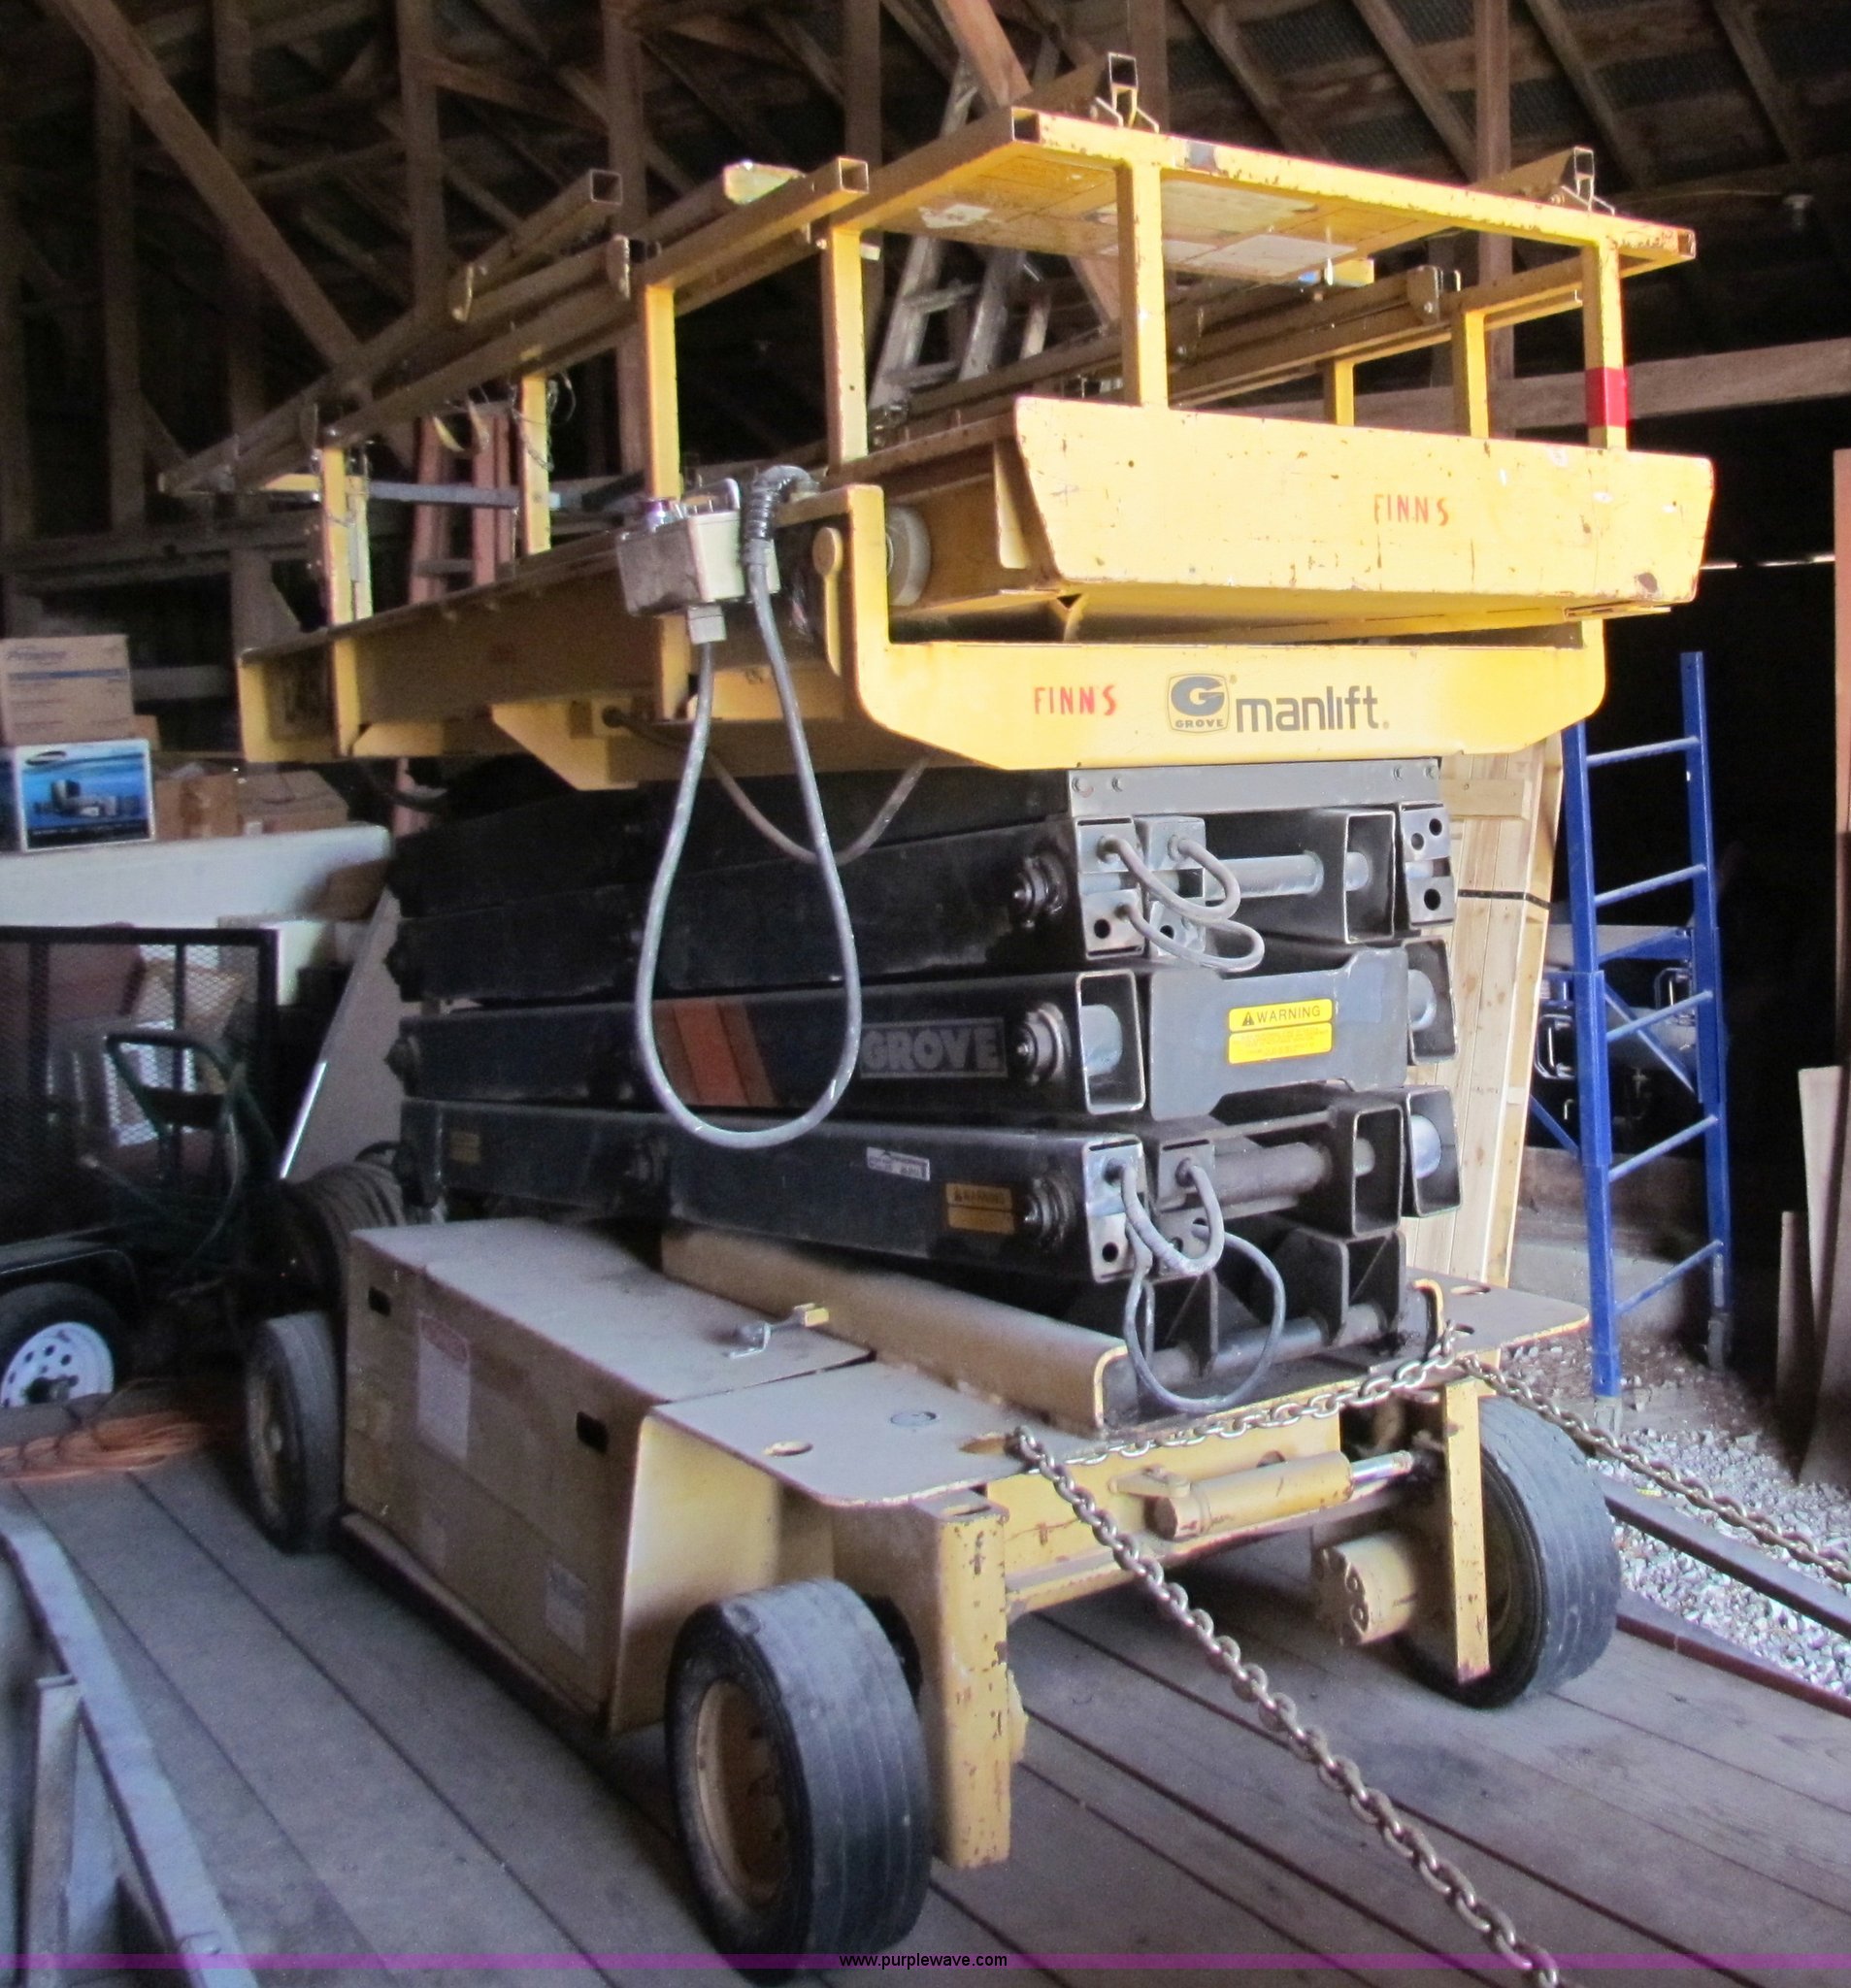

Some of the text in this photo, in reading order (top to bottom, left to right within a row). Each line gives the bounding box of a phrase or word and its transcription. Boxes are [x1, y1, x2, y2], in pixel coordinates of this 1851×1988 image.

[1174, 718, 1224, 729] GROVE
[1236, 684, 1379, 733] manlift
[1257, 1005, 1321, 1024] WARNING
[861, 1026, 1000, 1072] GROVE
